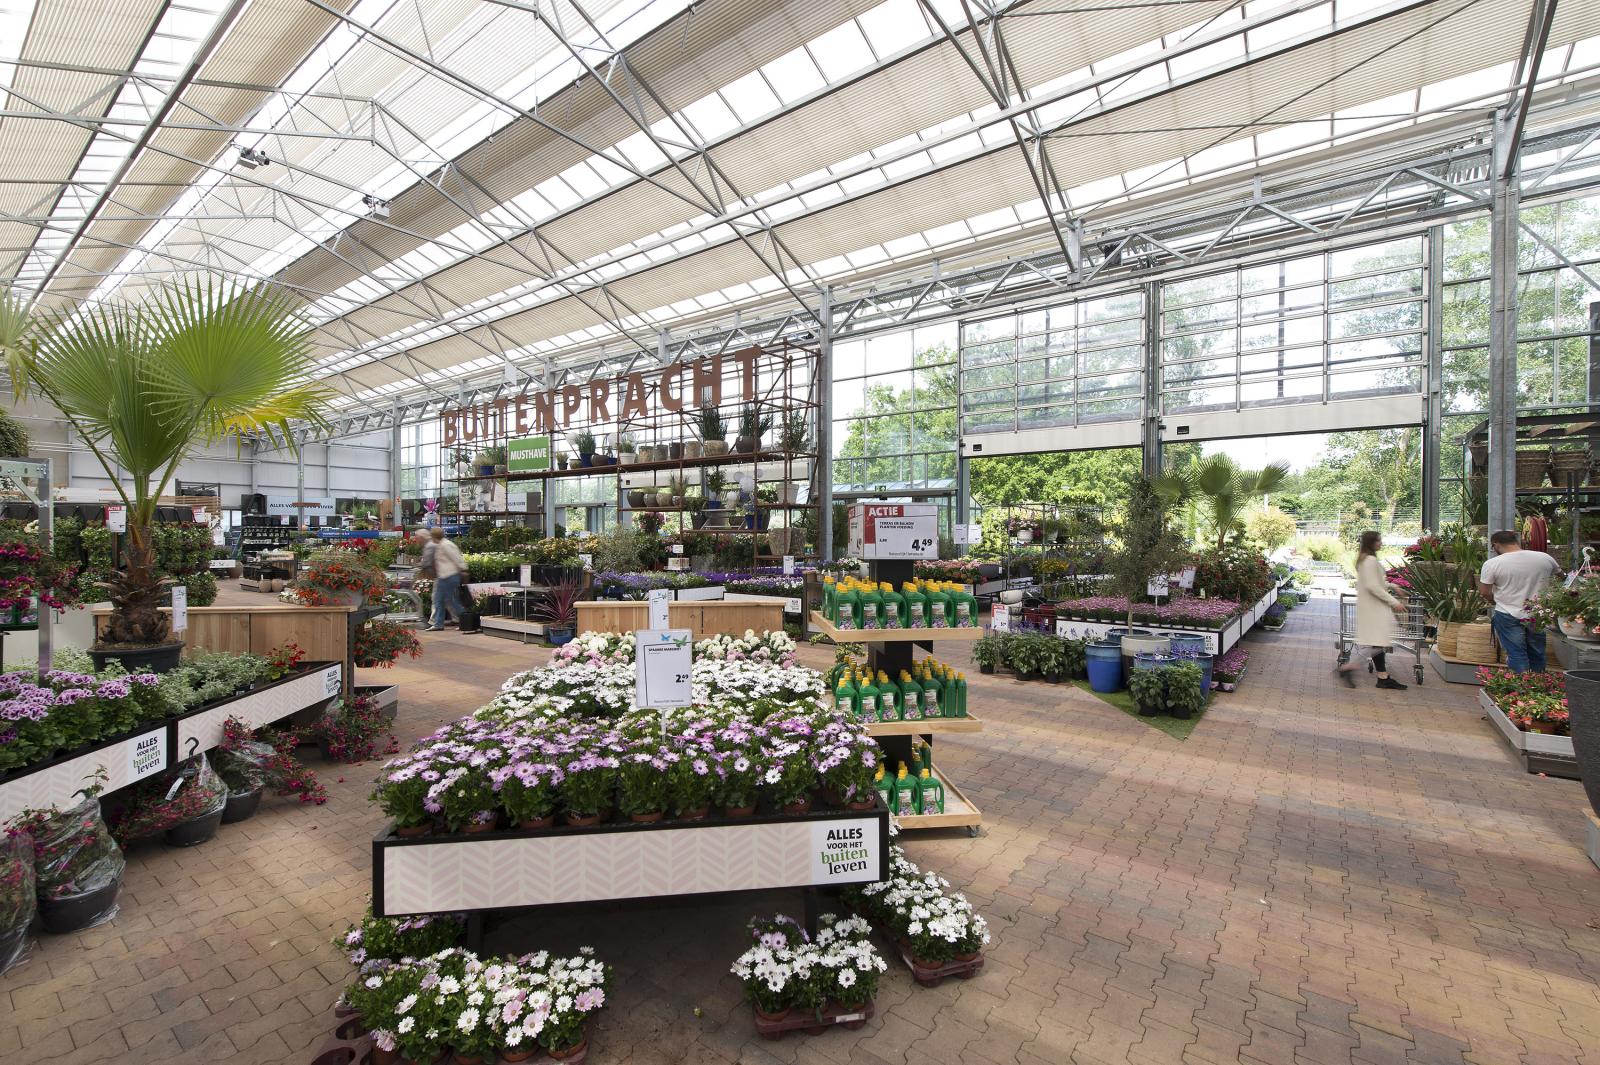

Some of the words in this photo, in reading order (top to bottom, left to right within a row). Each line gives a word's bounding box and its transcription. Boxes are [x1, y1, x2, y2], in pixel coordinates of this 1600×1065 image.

[443, 344, 762, 447] BUITENPRACHT
[510, 447, 547, 461] MUSTHAVE
[868, 506, 899, 516] ACTIE
[137, 736, 158, 750] ALLES
[133, 750, 160, 768] buiten
[136, 748, 149, 757] VOOR
[137, 758, 160, 774] leven
[827, 828, 863, 840] ALLES
[821, 849, 868, 864] buiten
[828, 860, 867, 875] leven
